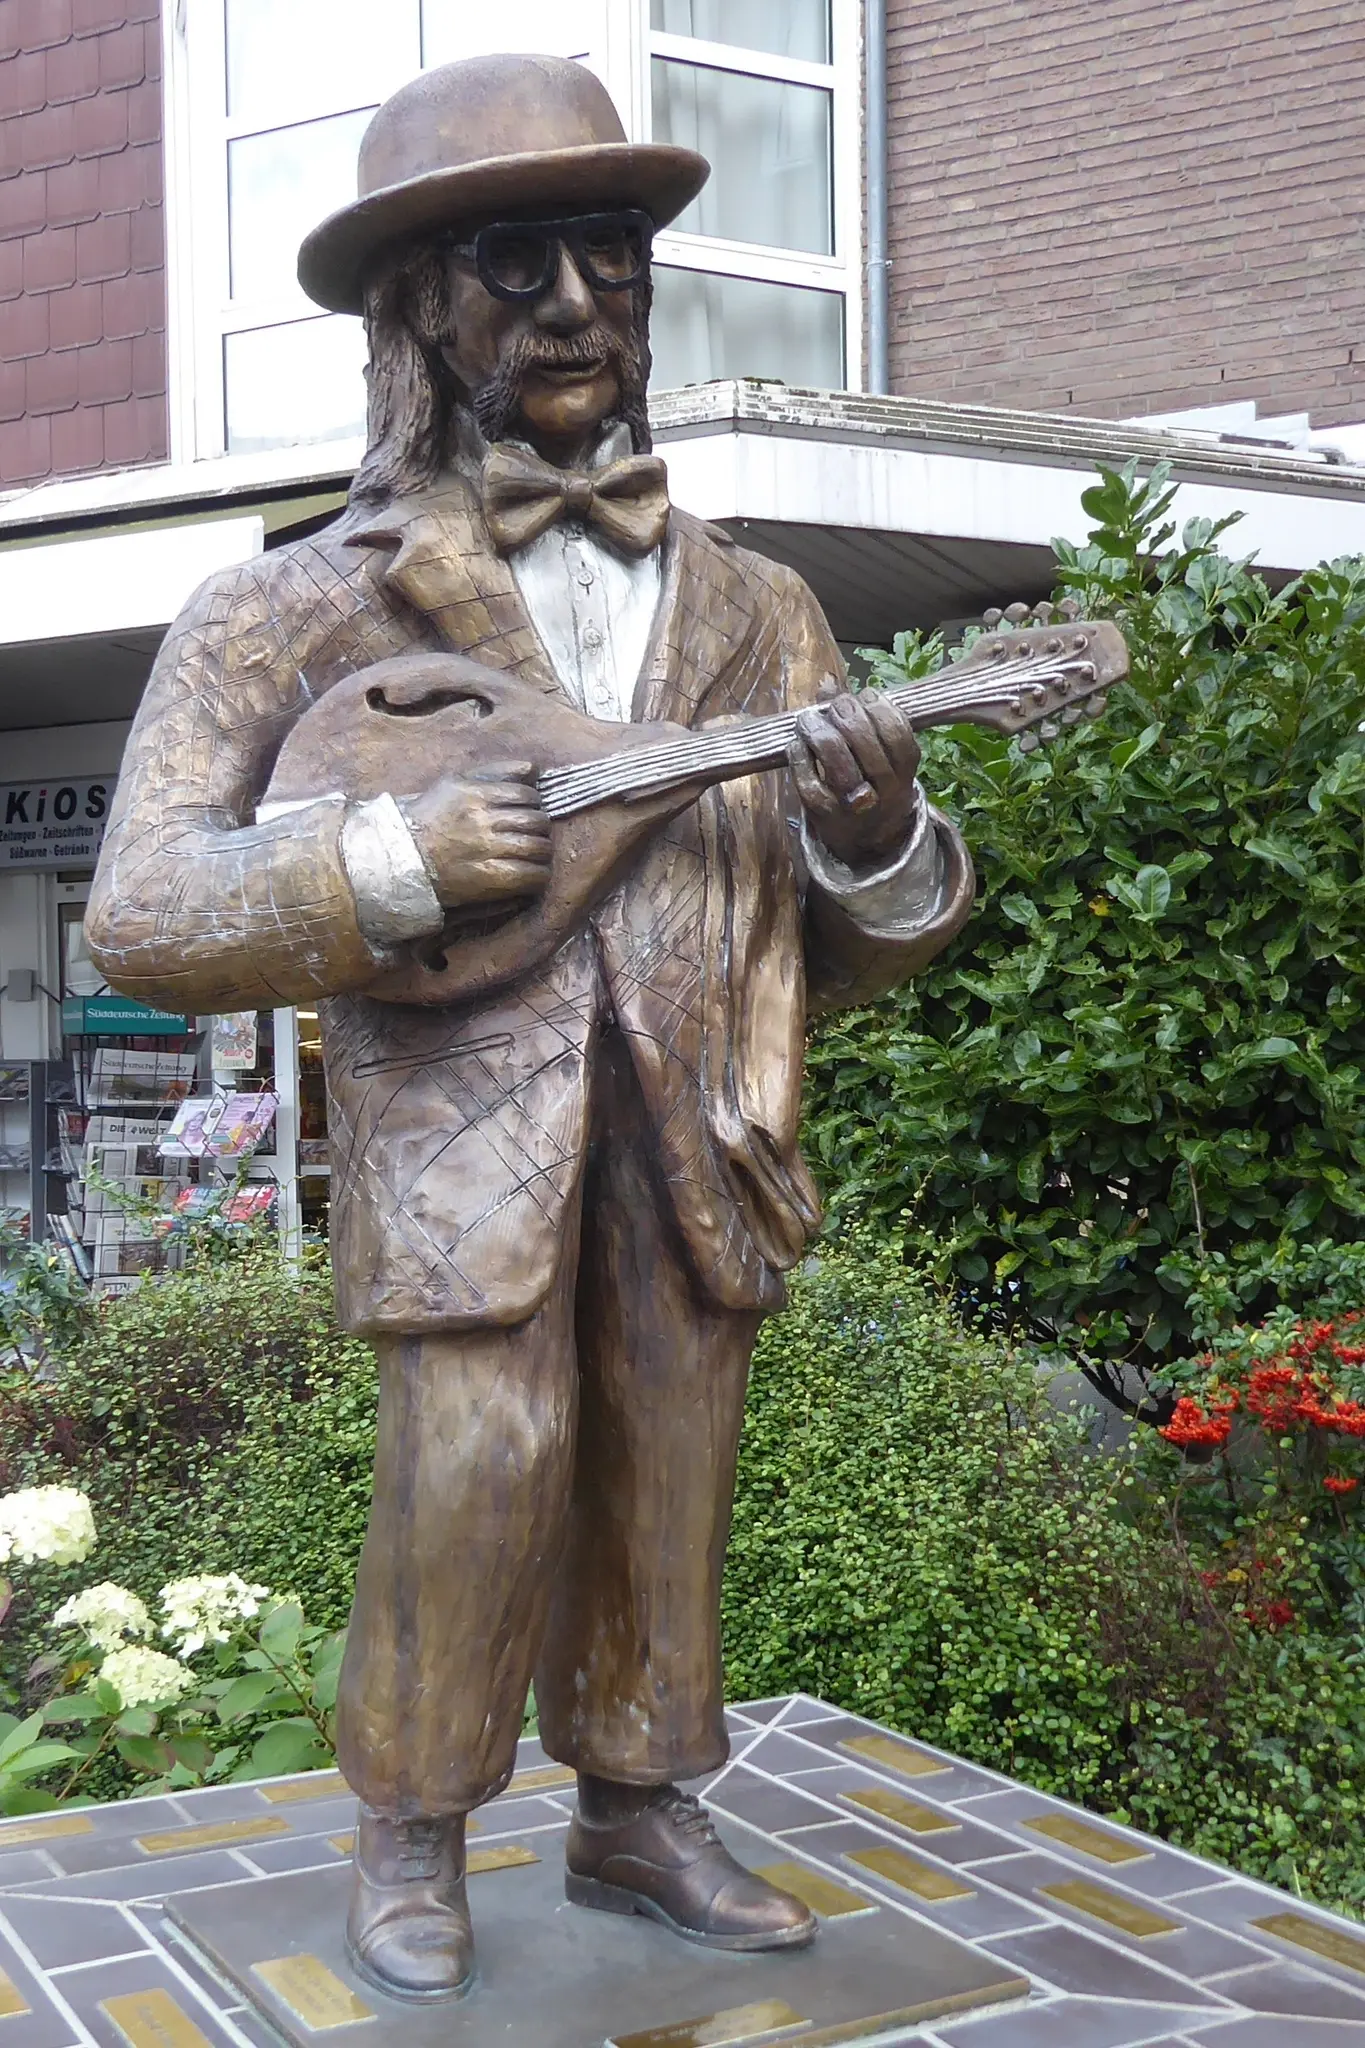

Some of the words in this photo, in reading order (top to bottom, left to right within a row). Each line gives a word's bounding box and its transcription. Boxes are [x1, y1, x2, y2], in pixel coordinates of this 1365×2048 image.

[0, 829, 37, 843] Zeitungen
[43, 825, 94, 840] Zeitschriften
[53, 843, 90, 857] Getränke
[86, 1007, 149, 1020] Süddeutsche
[103, 1060, 155, 1070] Süddeutsche
[109, 1124, 126, 1133] DIE
